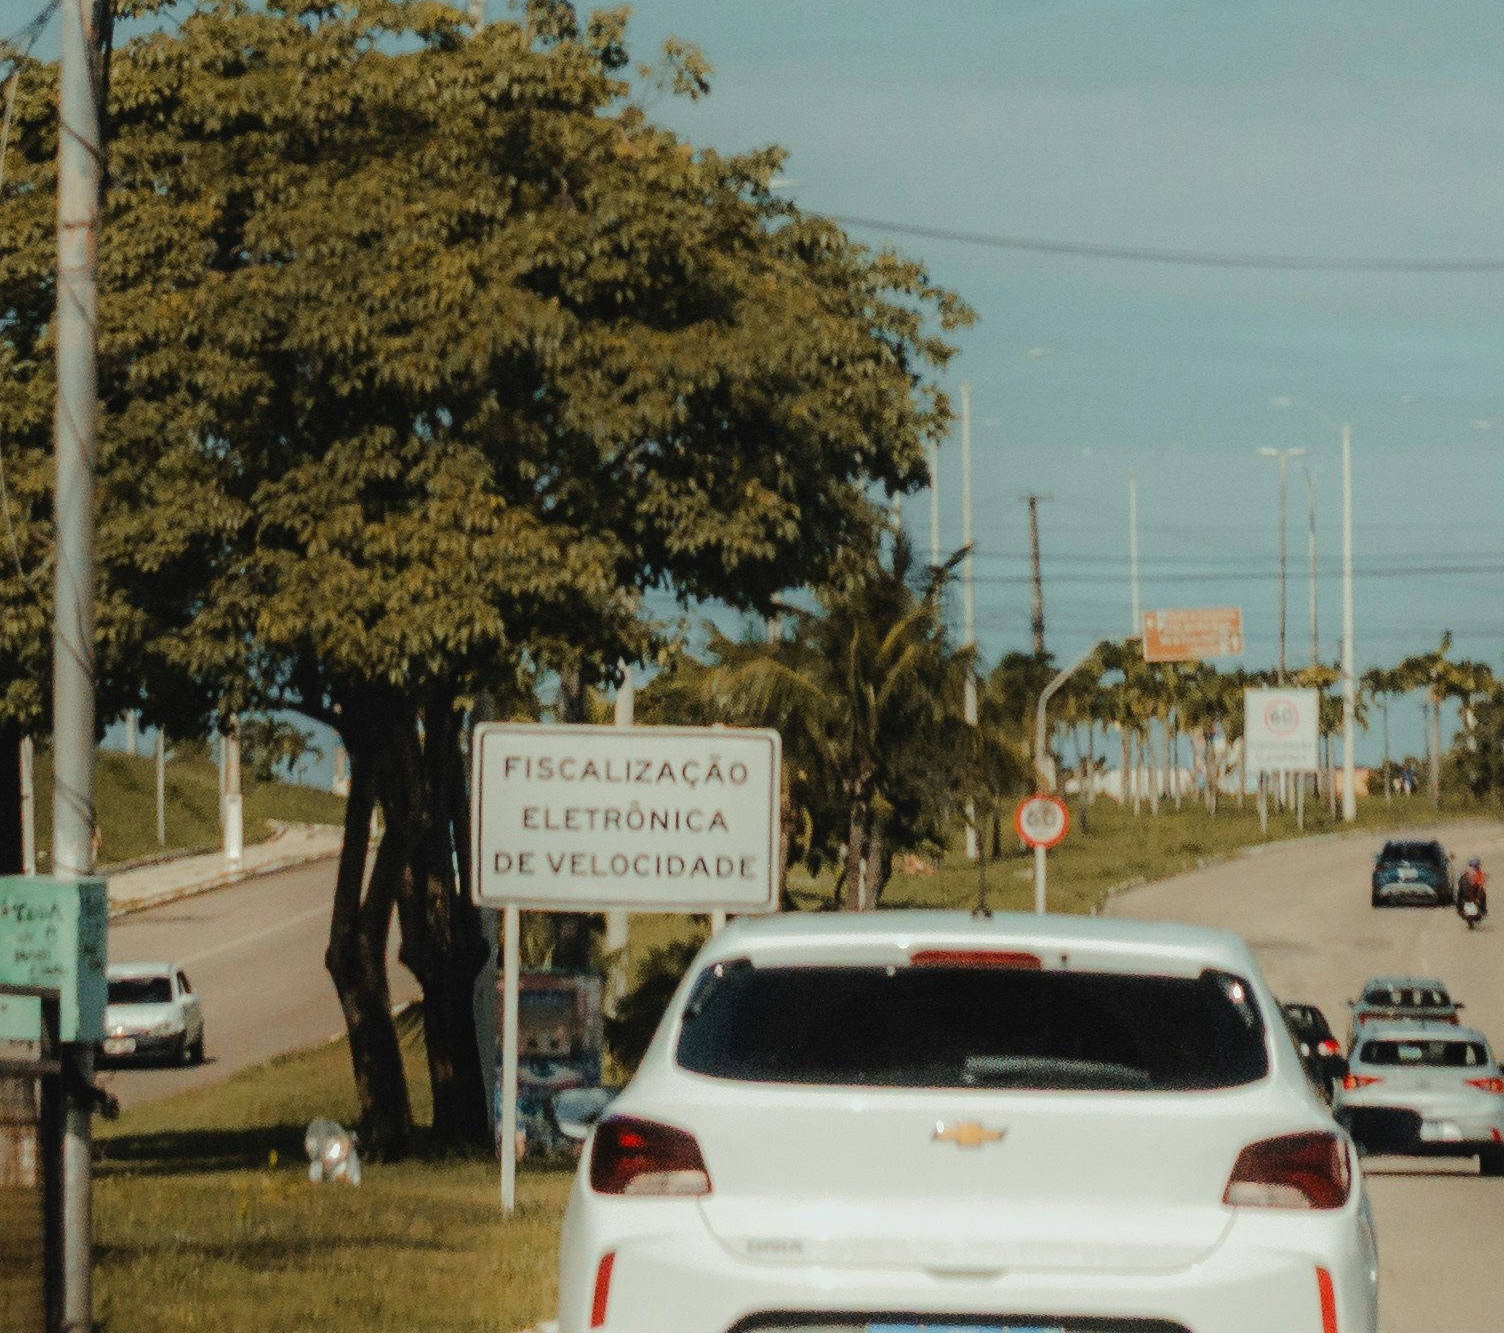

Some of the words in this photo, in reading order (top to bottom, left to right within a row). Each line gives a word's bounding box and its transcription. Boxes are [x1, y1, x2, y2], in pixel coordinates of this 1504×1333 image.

[504, 754, 748, 789] FISCALIZAÇÃO
[523, 800, 729, 832] ELETRÔNICA
[495, 853, 535, 875] DE
[547, 853, 757, 879] VELOCIDADE
